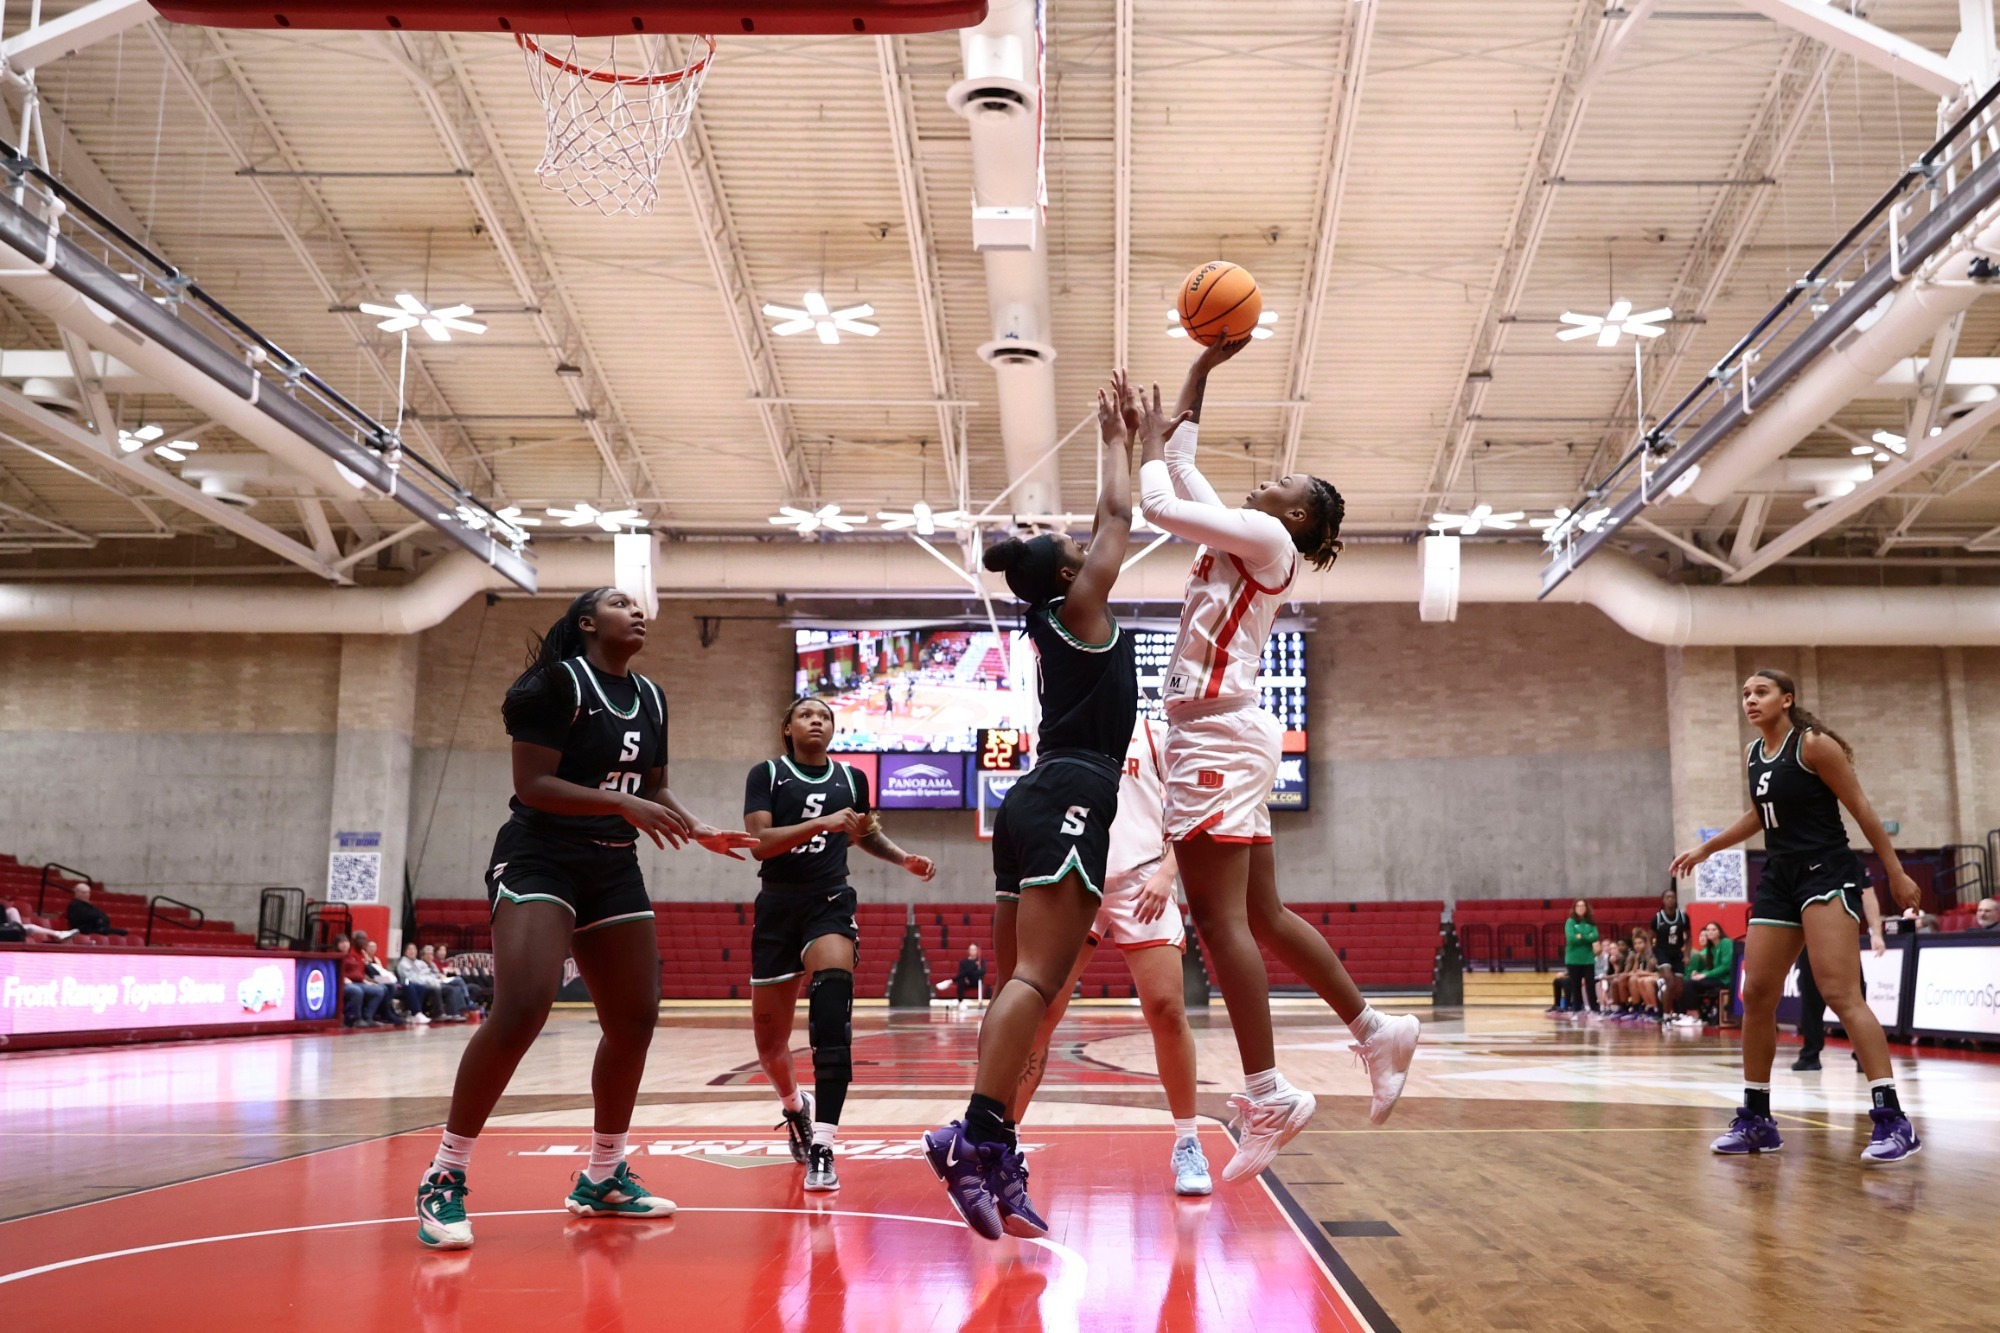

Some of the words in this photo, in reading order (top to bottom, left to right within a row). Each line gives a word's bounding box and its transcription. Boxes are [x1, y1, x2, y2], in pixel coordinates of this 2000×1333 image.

[619, 731, 641, 762] S
[983, 743, 1013, 768] 22
[1121, 757, 1140, 779] R
[599, 771, 642, 795] 20
[888, 777, 953, 789] PANORAMA
[1756, 770, 1773, 797] S
[801, 793, 827, 818] S
[1760, 802, 1779, 830] 11
[1060, 805, 1091, 836] S
[3, 976, 58, 1008] Front
[61, 976, 118, 1014] Range
[121, 976, 176, 1012] Toyota
[178, 976, 225, 1004] Stores
